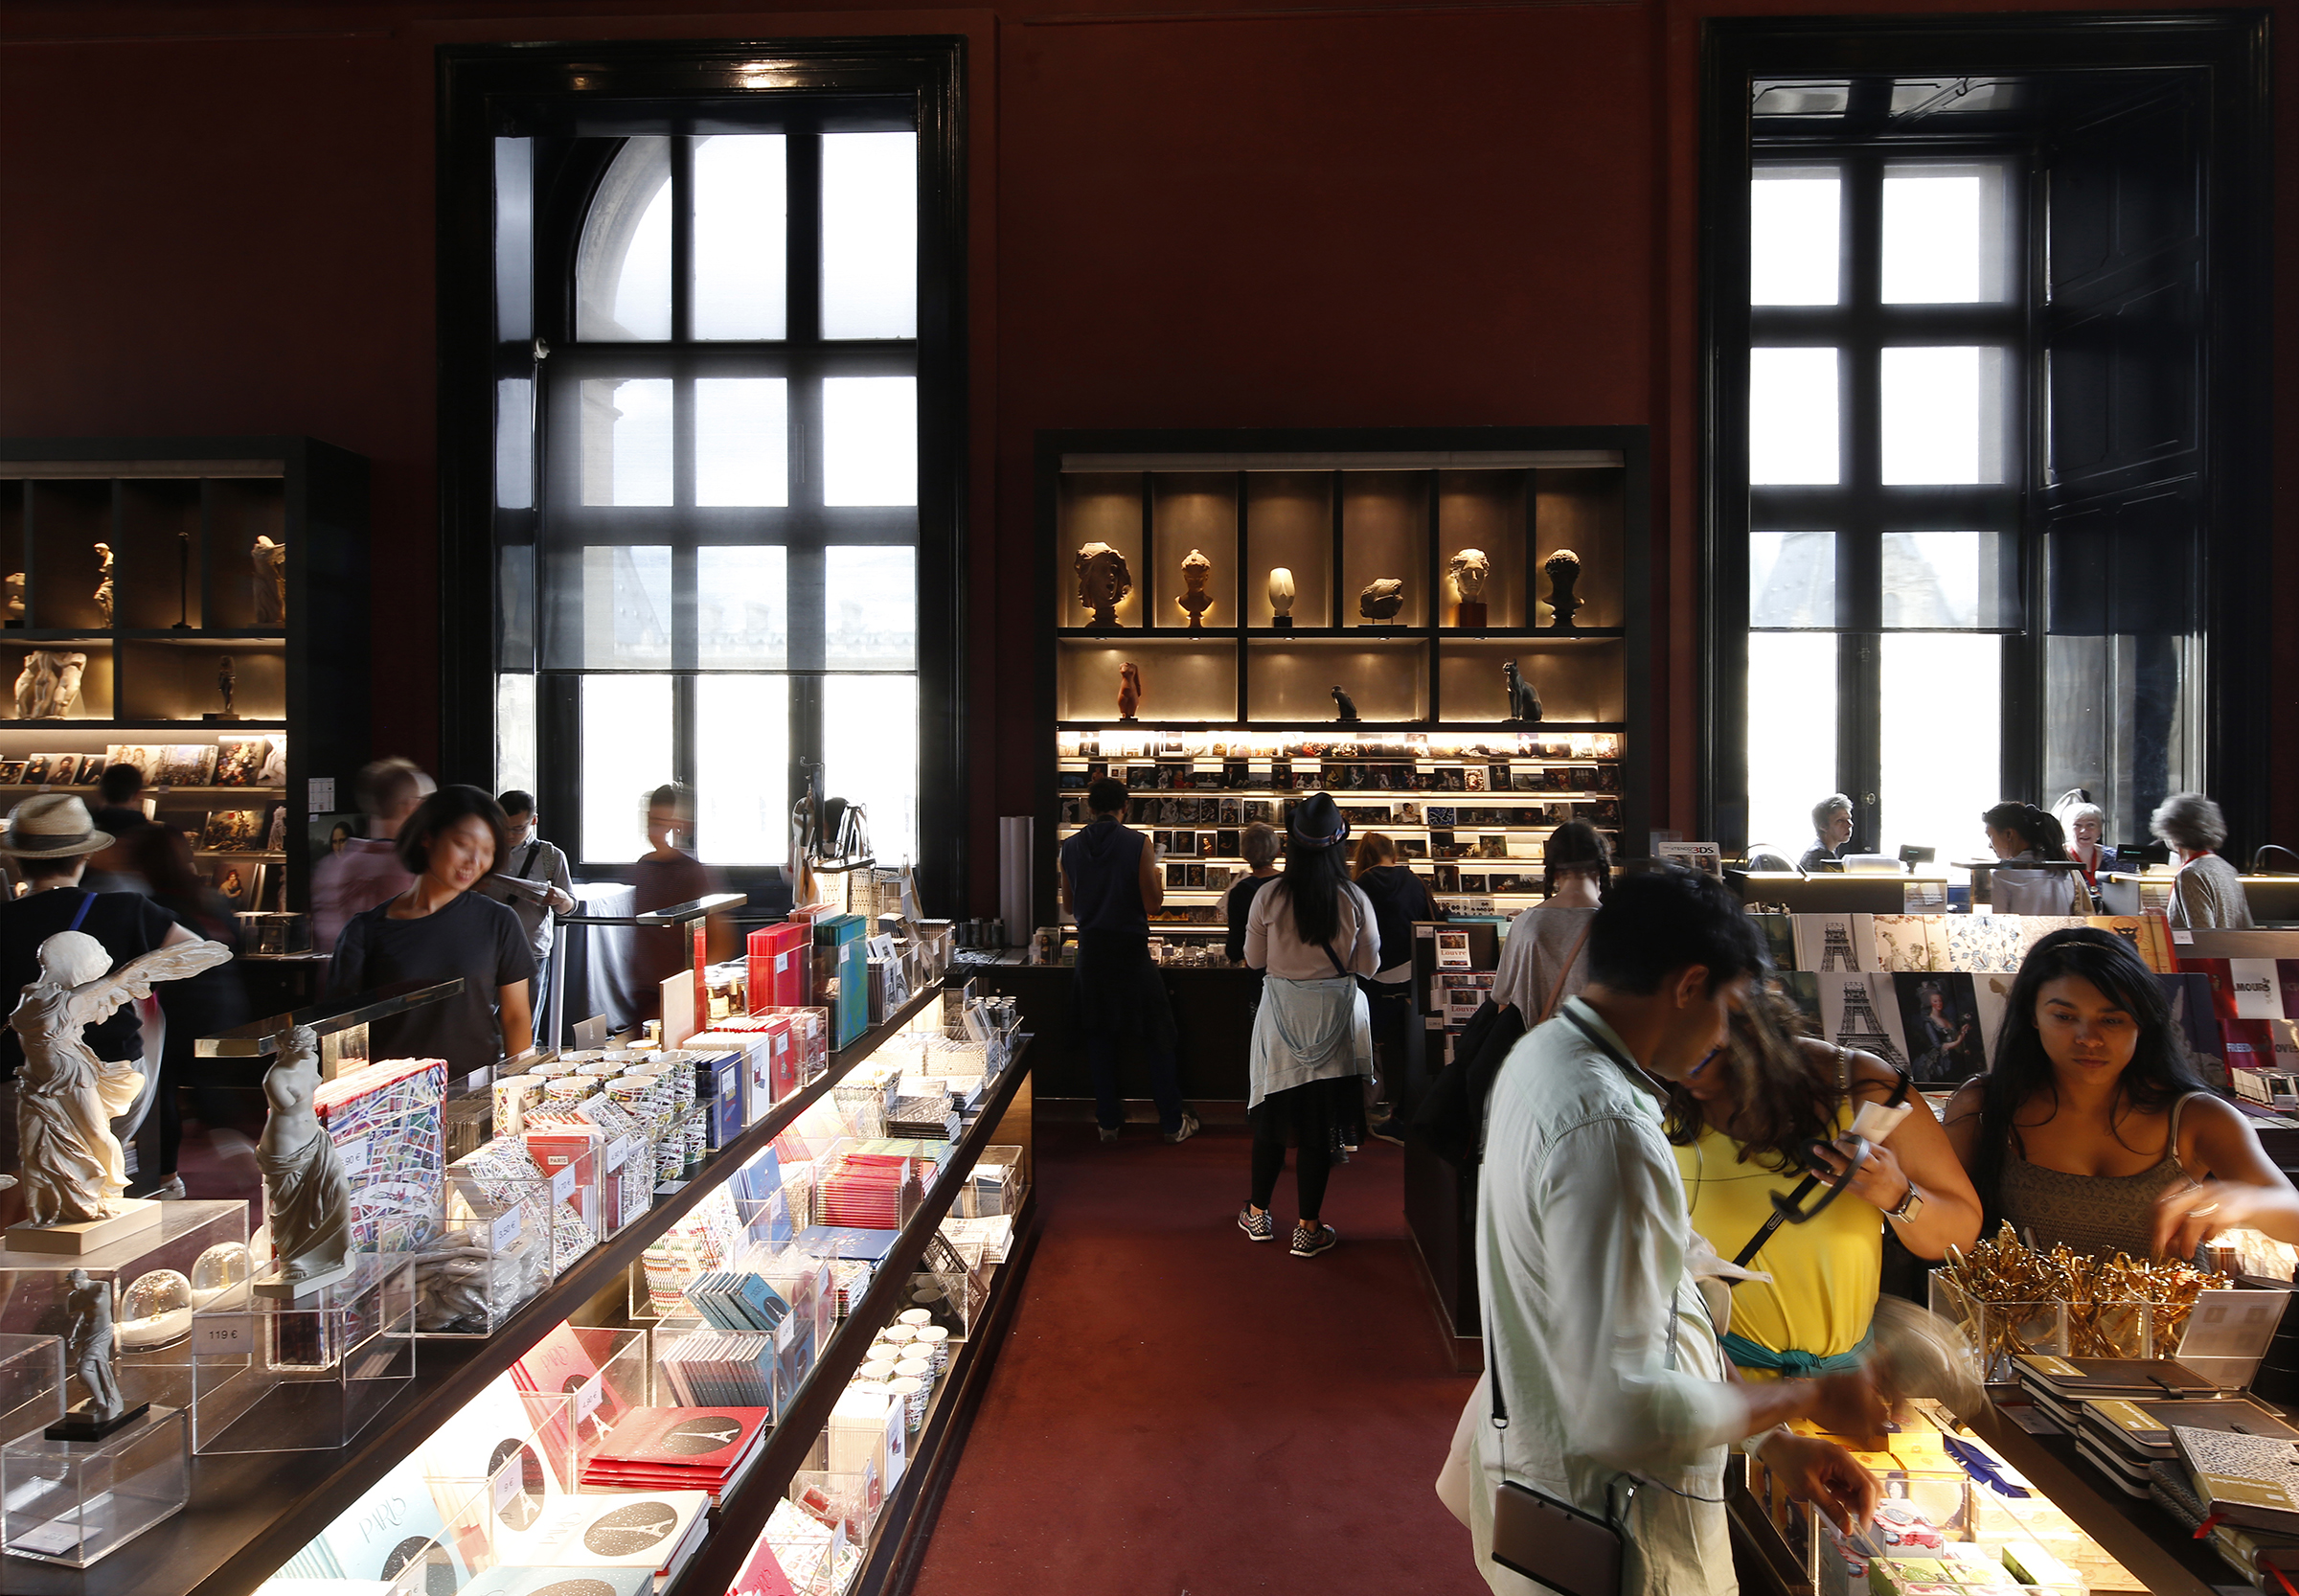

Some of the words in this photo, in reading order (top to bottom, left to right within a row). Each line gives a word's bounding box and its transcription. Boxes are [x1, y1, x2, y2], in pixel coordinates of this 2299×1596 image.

[2234, 983, 2271, 992] MOURS
[355, 1152, 361, 1161] €
[209, 1330, 228, 1339] 119
[231, 1329, 239, 1339] €
[539, 1344, 569, 1373] PARIS
[359, 1495, 407, 1543] PARIS
